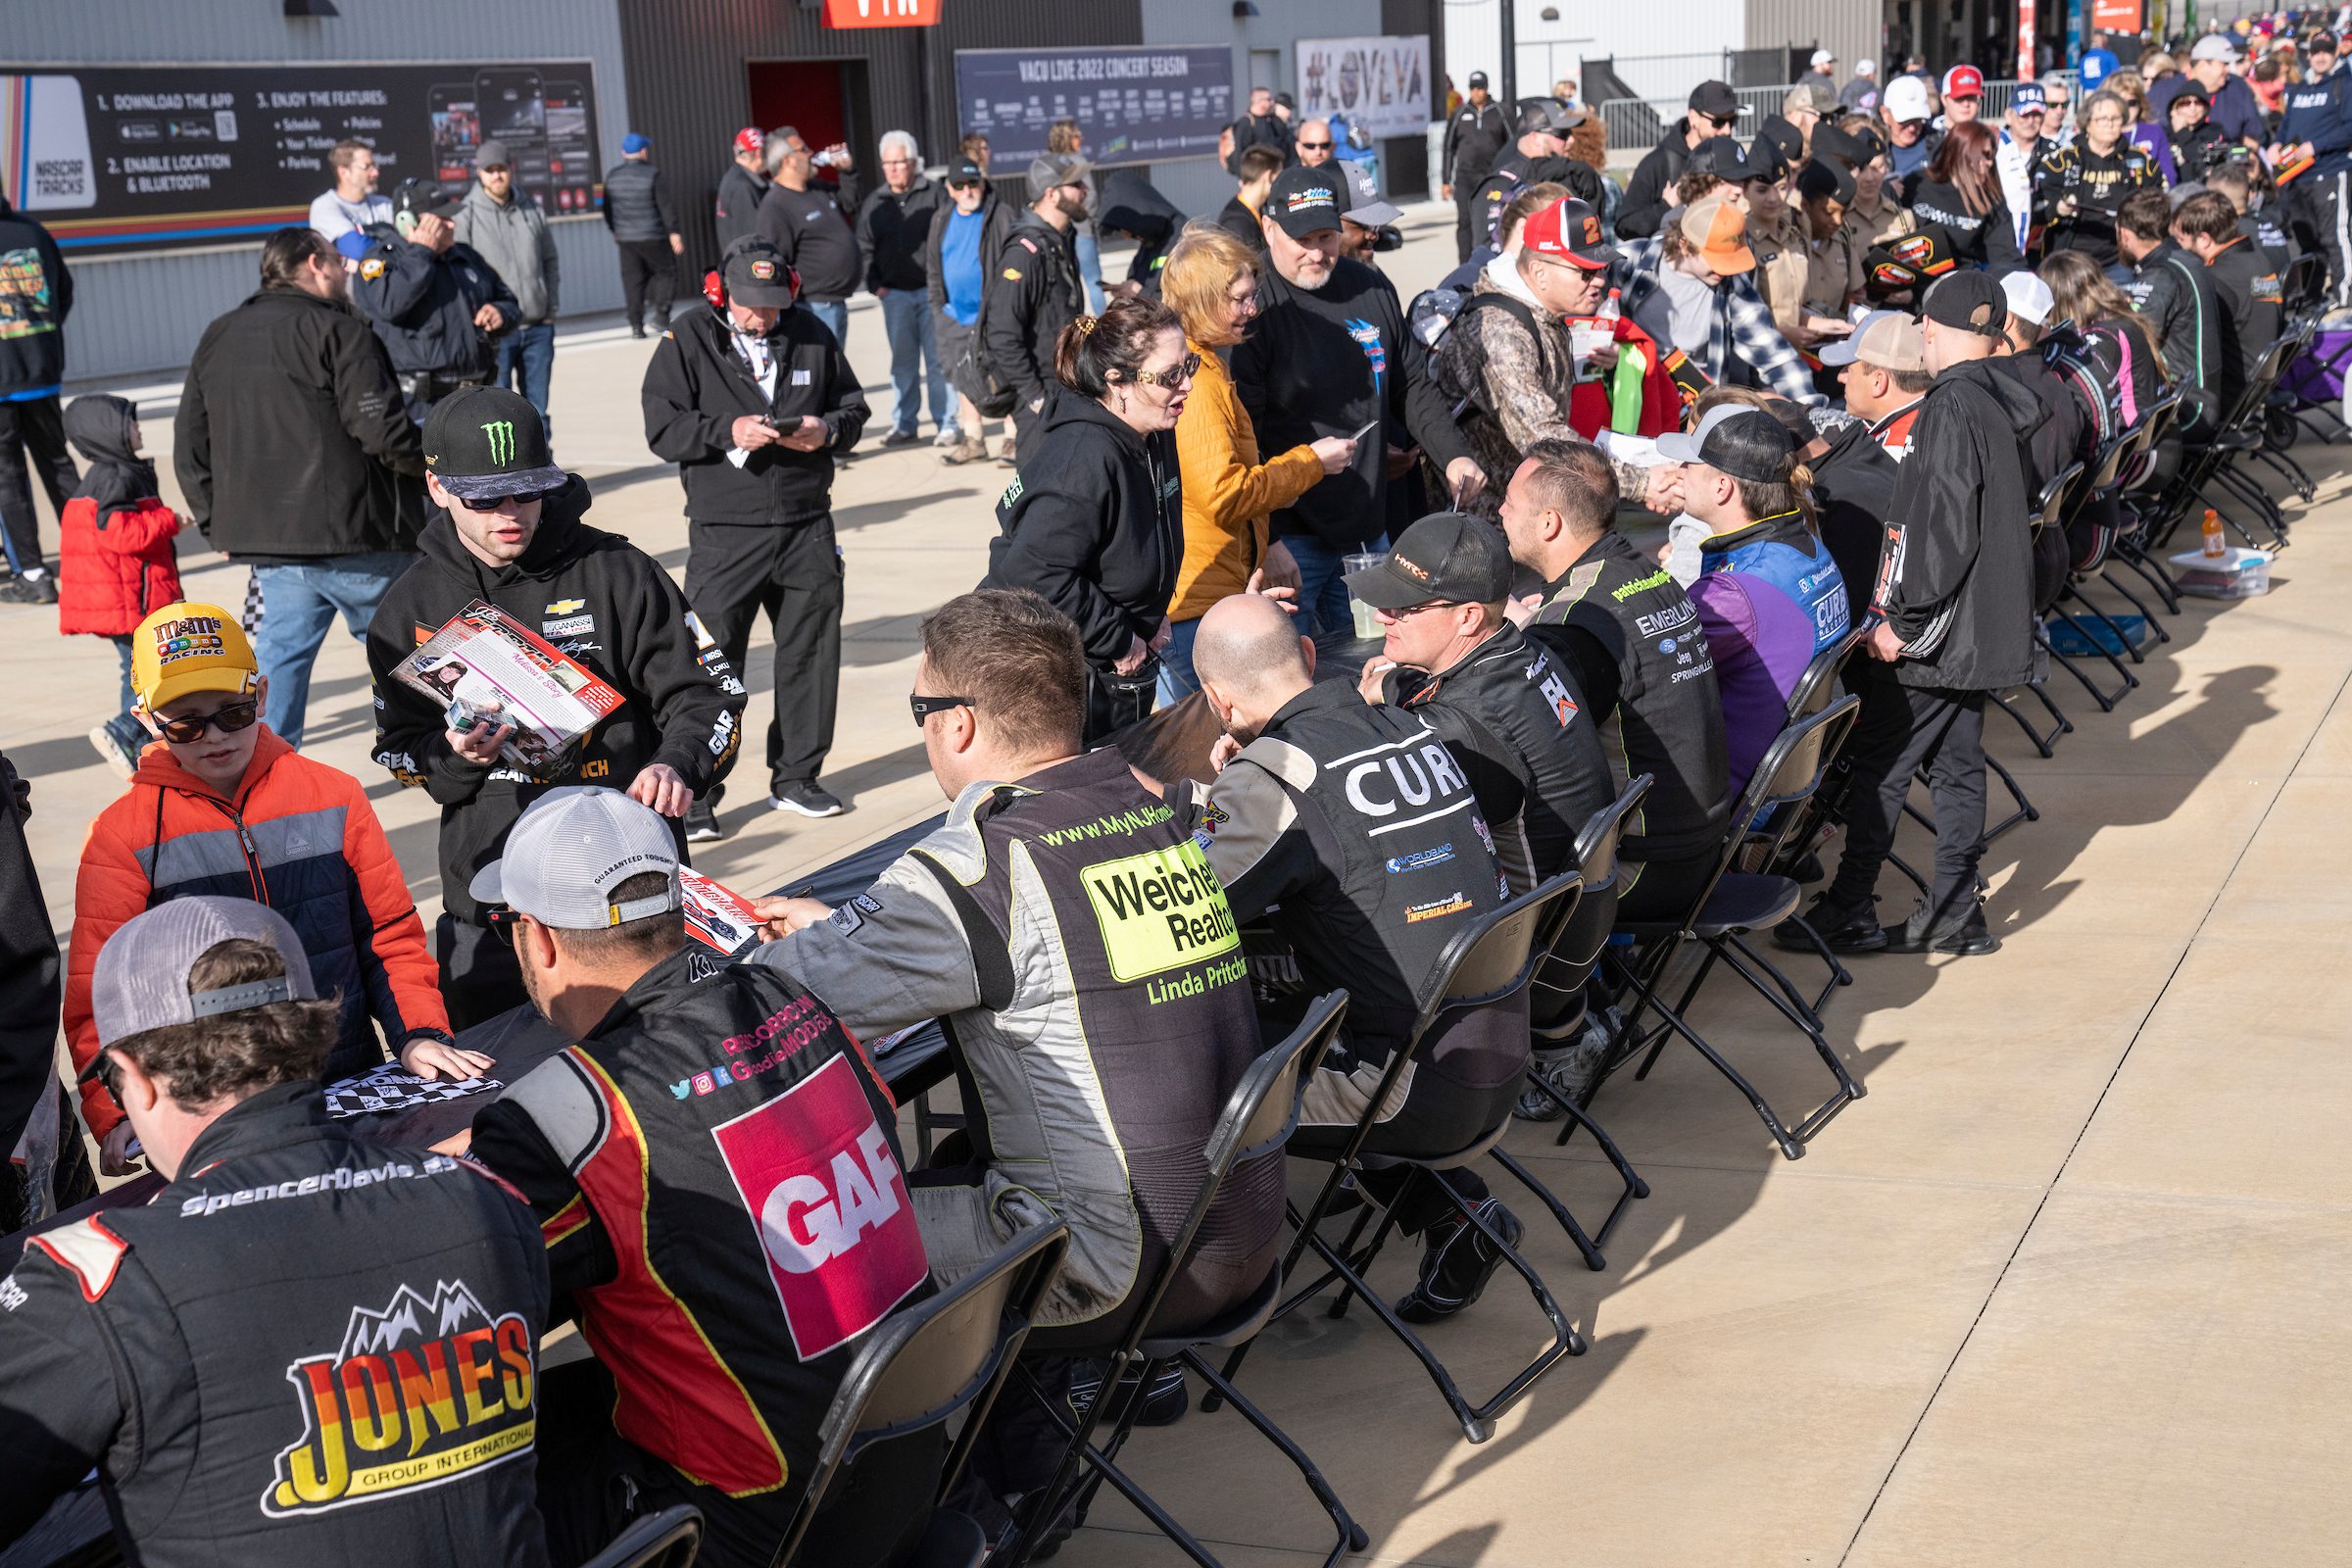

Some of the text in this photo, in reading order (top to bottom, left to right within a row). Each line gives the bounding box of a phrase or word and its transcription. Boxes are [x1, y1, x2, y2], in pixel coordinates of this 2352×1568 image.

[1051, 59, 1075, 81] LIVE
[1077, 58, 1104, 80] 2022
[1105, 57, 1150, 78] CONCERT
[1151, 55, 1189, 77] SEASON
[97, 92, 234, 111] 1. DOWNLOAD THE APP
[256, 89, 387, 108] 3. ENJOY THE FEATURES:
[2018, 88, 2043, 102] USA
[282, 118, 320, 131] Schedule
[35, 160, 83, 176] NASCAR
[107, 153, 231, 174] 2. ENABLE LOCATION
[36, 177, 84, 196] TRACKS
[126, 173, 211, 193] & BLUETOOTH
[1816, 586, 1846, 628] CURB
[545, 625, 592, 637] RACING
[554, 617, 591, 631] GANASSI
[684, 611, 716, 650] 1
[160, 649, 225, 665] RACING
[1677, 651, 1692, 664] Jeep
[543, 679, 564, 699] Story
[708, 709, 734, 755] GEAR
[1346, 740, 1468, 816] CUR
[594, 855, 643, 884] GUARANTEED
[1094, 858, 1224, 921] Weicher
[1406, 906, 1447, 923] IMPERIAL
[1146, 970, 1203, 1005] Linda
[761, 1120, 901, 1274] GAF
[275, 1318, 532, 1506] JONES
[363, 1426, 533, 1487] GROUP INTERNATIONAL
